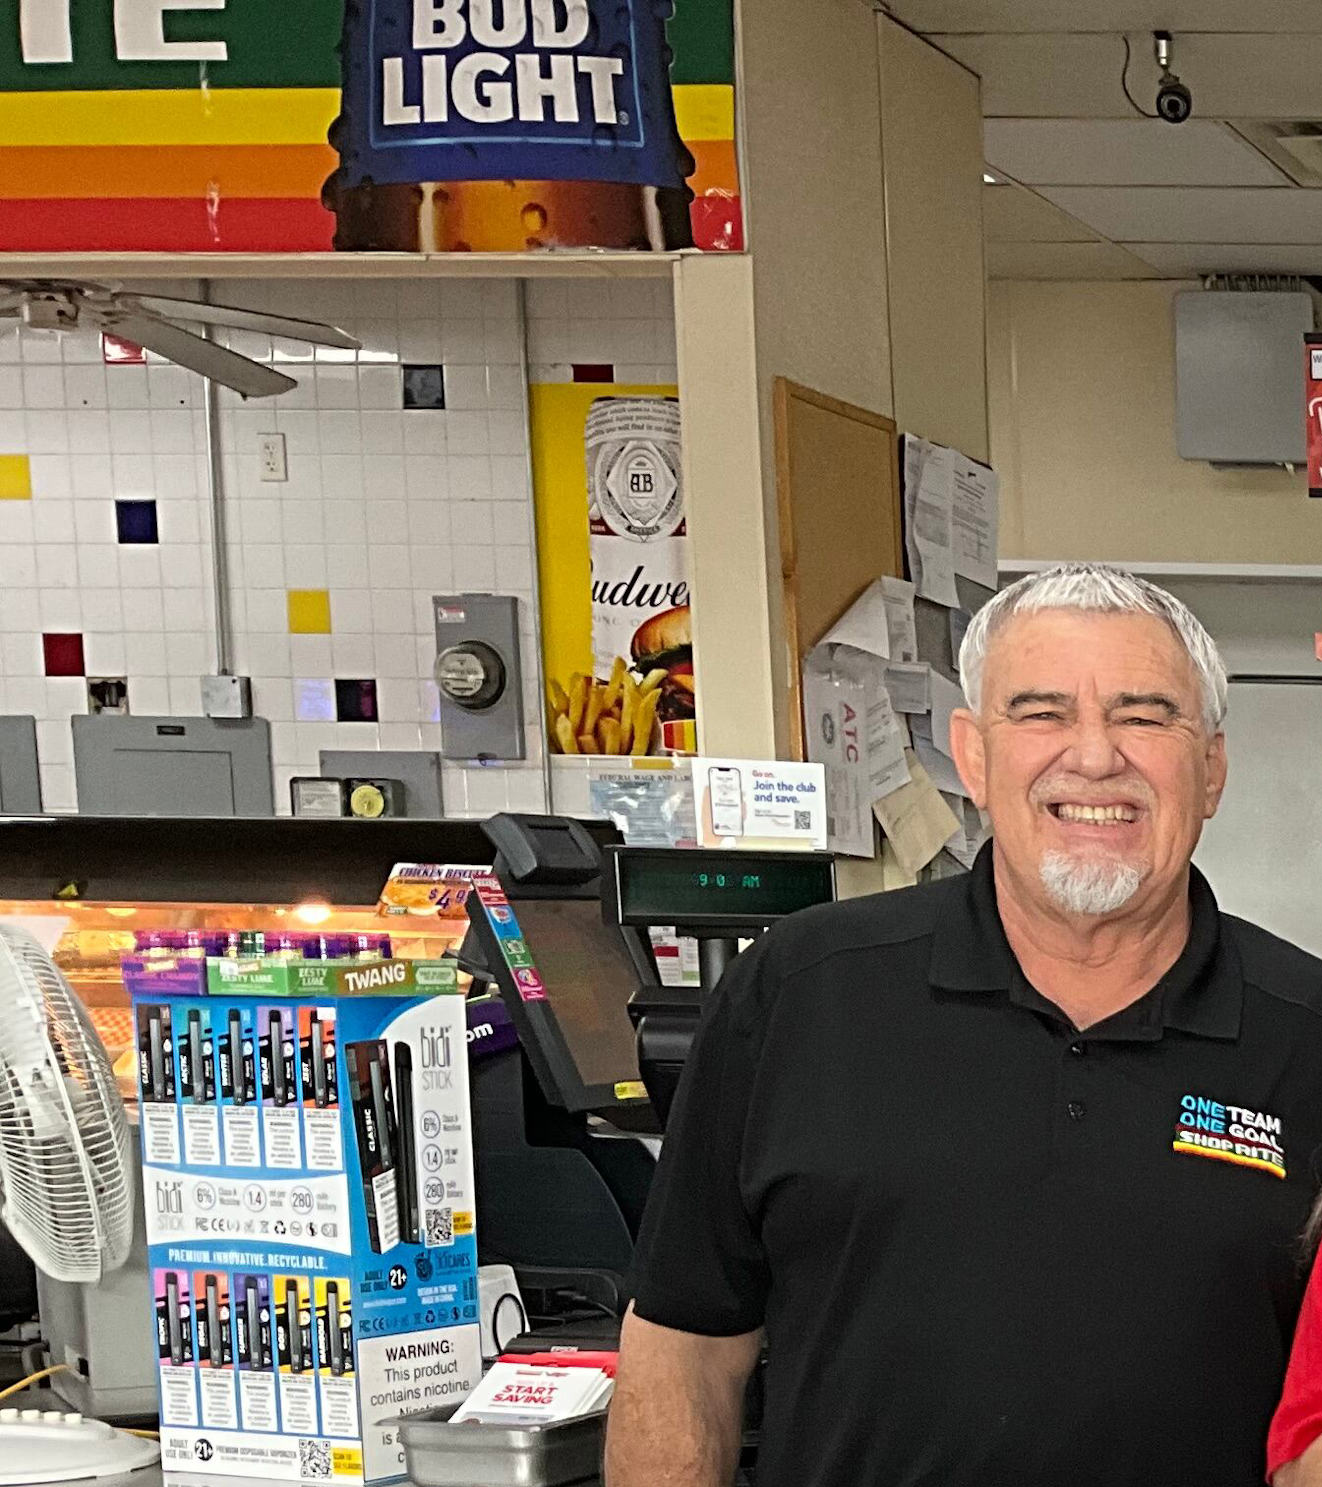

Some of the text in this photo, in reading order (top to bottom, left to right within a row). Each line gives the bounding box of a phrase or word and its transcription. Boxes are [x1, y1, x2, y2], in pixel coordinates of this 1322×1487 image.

[411, 0, 591, 50] BUD
[381, 52, 625, 125] LIGHT
[753, 781, 816, 793] Join the club
[754, 793, 800, 804] and save.
[344, 963, 406, 992] TWANG
[420, 1025, 452, 1069] bidi
[422, 1071, 452, 1090] STICK
[1181, 1095, 1281, 1134] ONE TEAM
[1180, 1111, 1284, 1153] ONE GOAL
[156, 1181, 184, 1214] bidi
[386, 1340, 454, 1362] WARNING:
[384, 1360, 458, 1383] This product
[370, 1379, 473, 1406] contains nicotine.
[492, 1394, 554, 1404] SAVING
[503, 1385, 558, 1395] START
